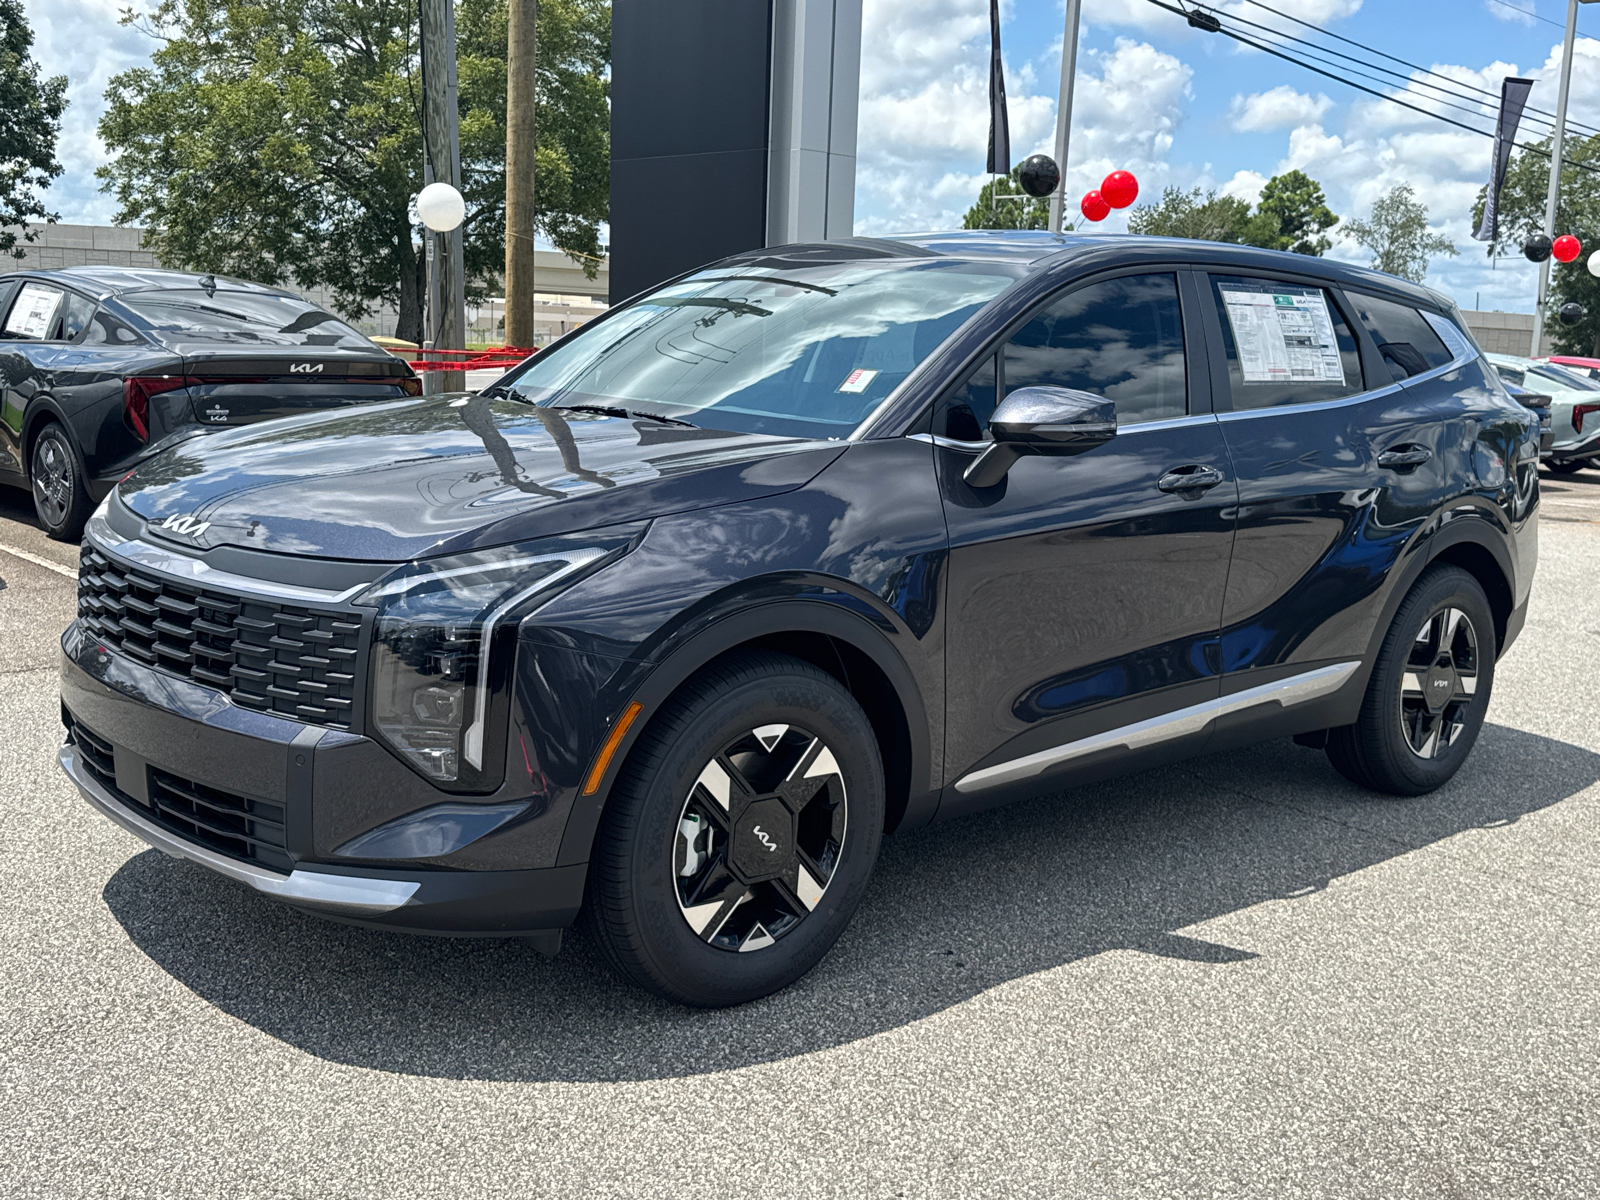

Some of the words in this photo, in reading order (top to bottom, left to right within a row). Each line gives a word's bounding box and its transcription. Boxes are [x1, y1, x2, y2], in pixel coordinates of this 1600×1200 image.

[289, 363, 324, 373] KIA
[161, 513, 211, 538] KIA
[753, 825, 778, 851] KIA
